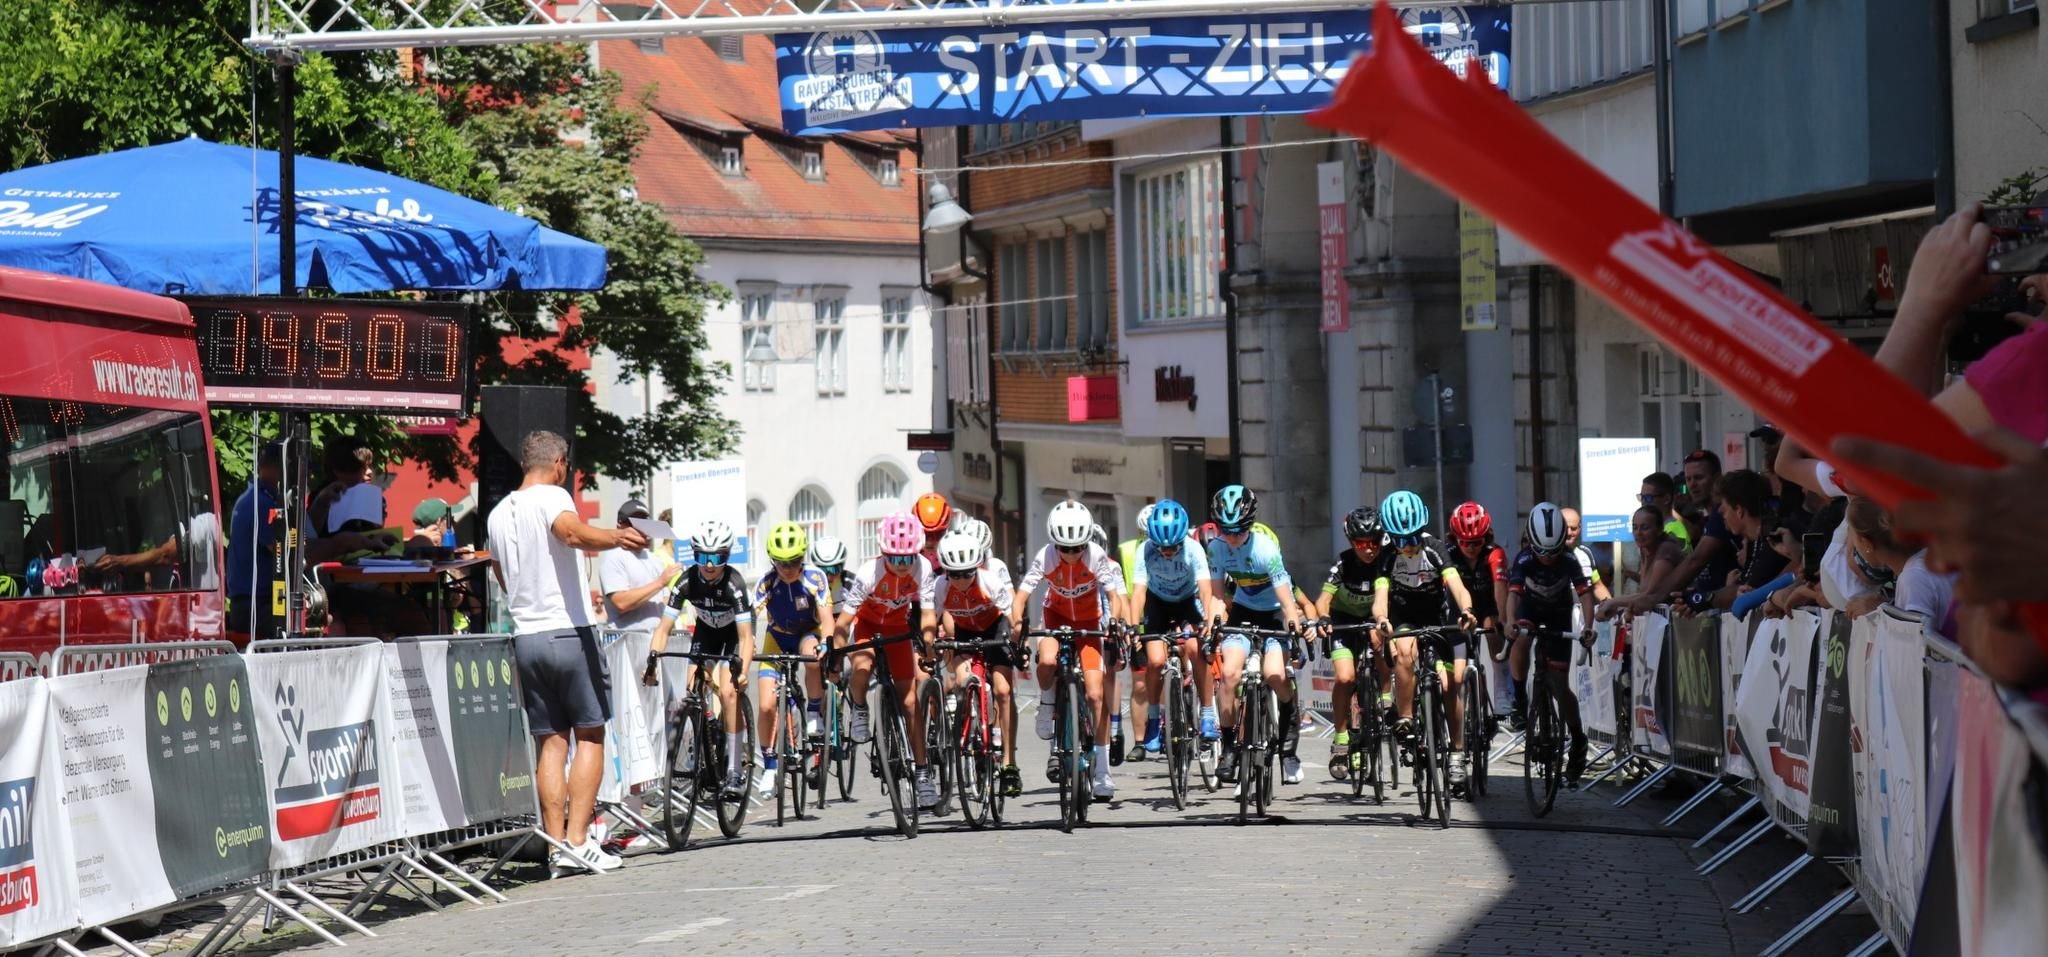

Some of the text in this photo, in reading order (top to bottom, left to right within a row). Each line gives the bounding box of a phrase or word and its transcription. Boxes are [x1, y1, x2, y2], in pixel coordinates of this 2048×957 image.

[935, 26, 1151, 97] START
[1206, 22, 1345, 84] ZIEL
[798, 68, 888, 98] RAVENSBURGER
[810, 82, 909, 113] ALTSTADTRENNEN
[3, 187, 121, 199] GETRÄNKE
[1321, 207, 1344, 236] DUAL
[1322, 237, 1339, 267] STU
[1323, 268, 1338, 297] DIE
[92, 358, 200, 401] www.raceresult.ch
[226, 822, 264, 848] enerquinn
